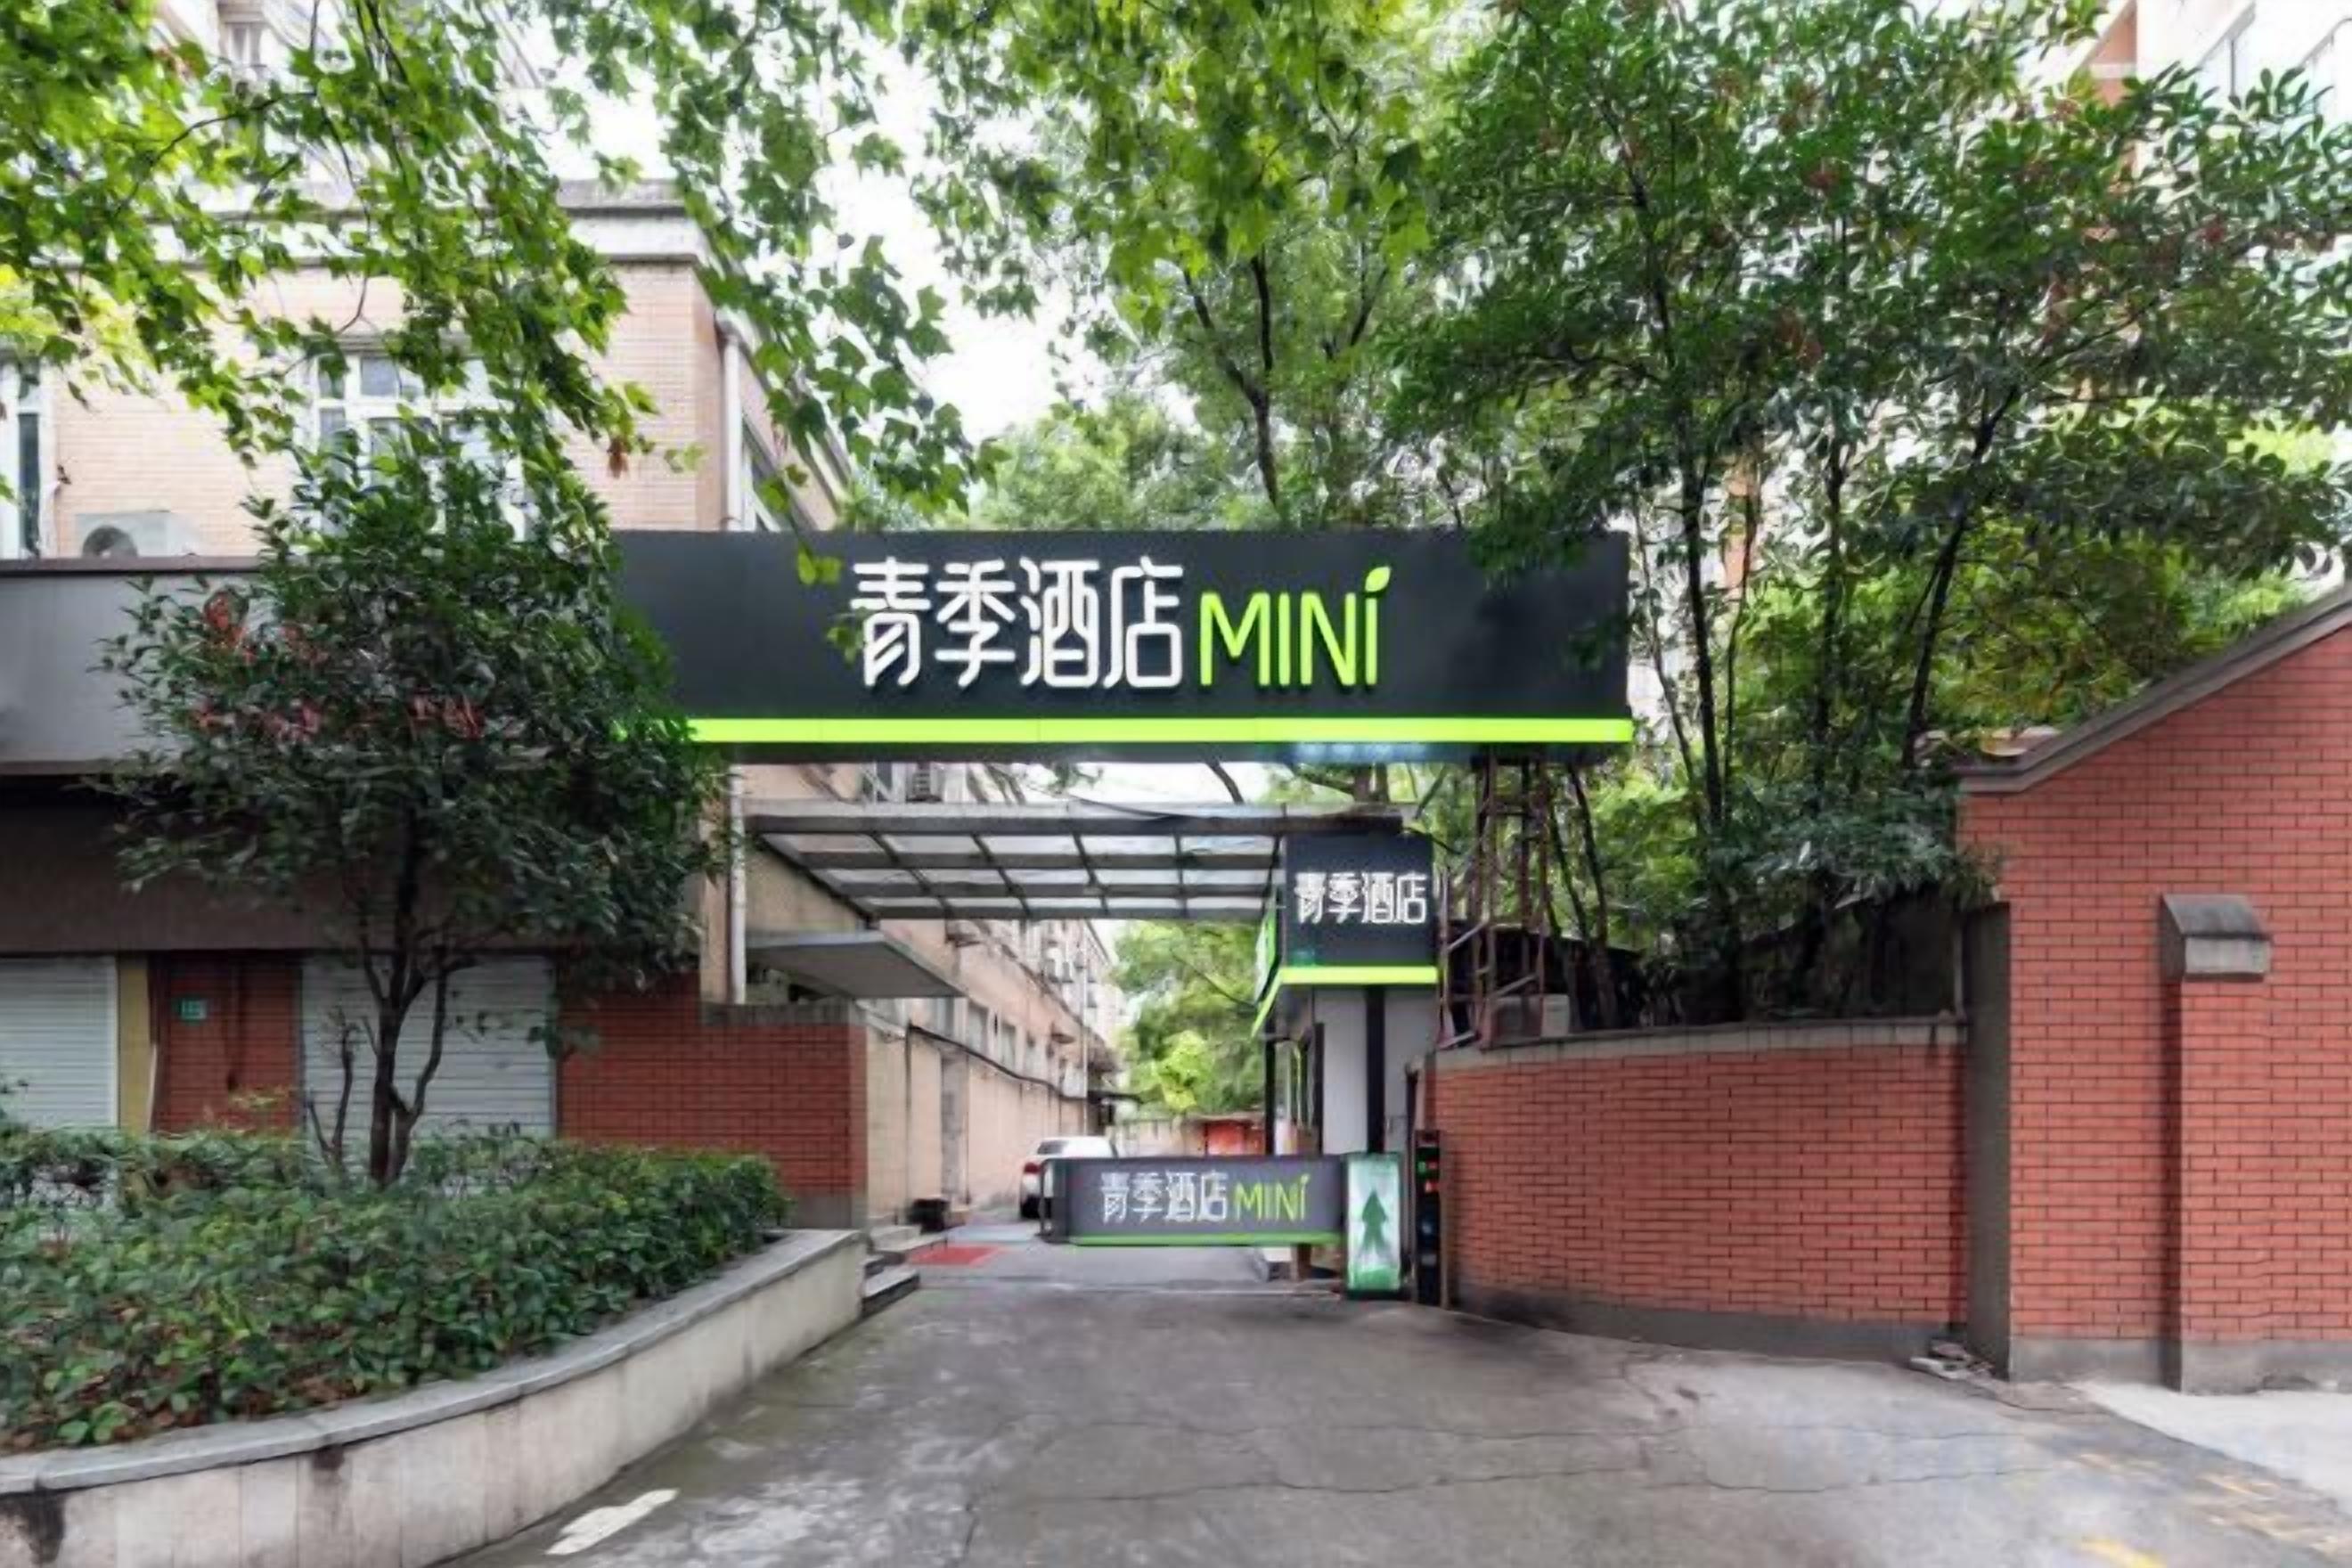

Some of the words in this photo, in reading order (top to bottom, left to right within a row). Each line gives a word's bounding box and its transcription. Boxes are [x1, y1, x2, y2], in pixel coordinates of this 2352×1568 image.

[850, 556, 1183, 689] 青季酒店
[1294, 870, 1428, 925] 青季酒店
[1099, 1170, 1228, 1225] 青季酒店
